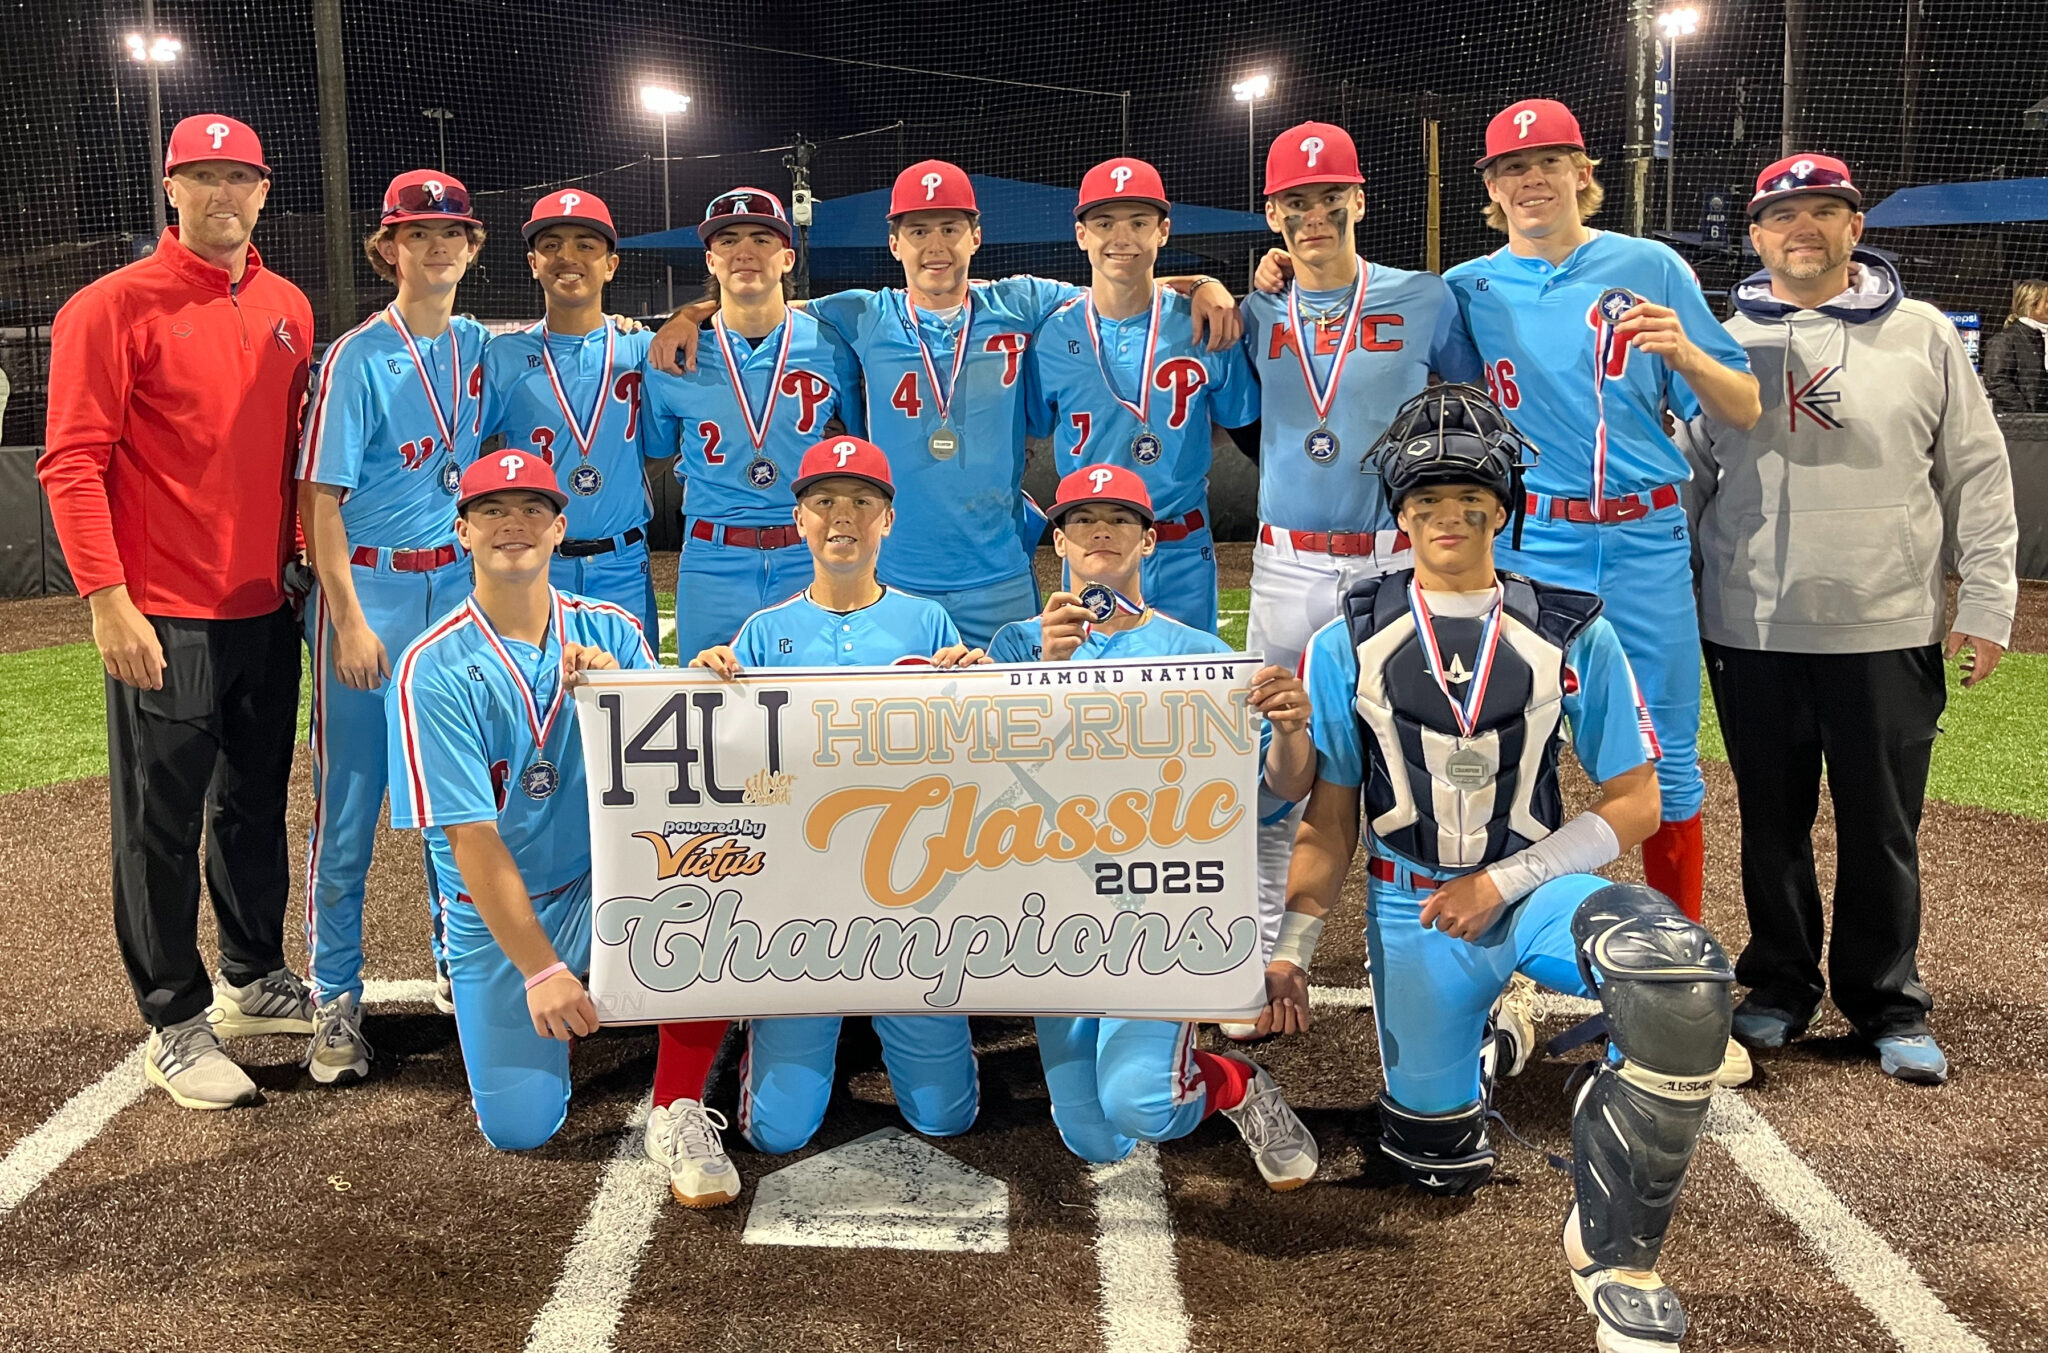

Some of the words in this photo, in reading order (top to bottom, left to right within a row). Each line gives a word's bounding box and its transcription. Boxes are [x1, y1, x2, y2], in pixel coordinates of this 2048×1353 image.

[1513, 109, 1537, 139] P
[1653, 103, 1663, 131] 5
[206, 123, 230, 150] P
[1299, 136, 1325, 168] P
[421, 180, 444, 206] P
[920, 172, 942, 201] P
[1110, 166, 1132, 193] P
[560, 193, 581, 216] P
[1711, 225, 1719, 238] 6
[1268, 313, 1404, 360] KBC
[780, 369, 832, 435] P
[891, 371, 923, 418] 4
[1152, 356, 1208, 430] P
[530, 426, 555, 467] 3
[698, 420, 725, 466] 2
[1070, 412, 1092, 456] 7
[499, 455, 524, 481] P
[833, 441, 856, 468] P
[1088, 468, 1113, 494] P
[1010, 670, 1124, 686] DIAMOND
[1141, 666, 1235, 682] NATION
[812, 692, 1055, 767] HOME
[1063, 690, 1254, 760] RUN
[597, 688, 791, 808] 14U
[663, 819, 740, 838] powered
[741, 819, 767, 839] by
[802, 757, 1247, 908] Classic
[631, 831, 767, 882] Victus
[1094, 860, 1224, 896] 2025
[596, 884, 1257, 1008] Champions
